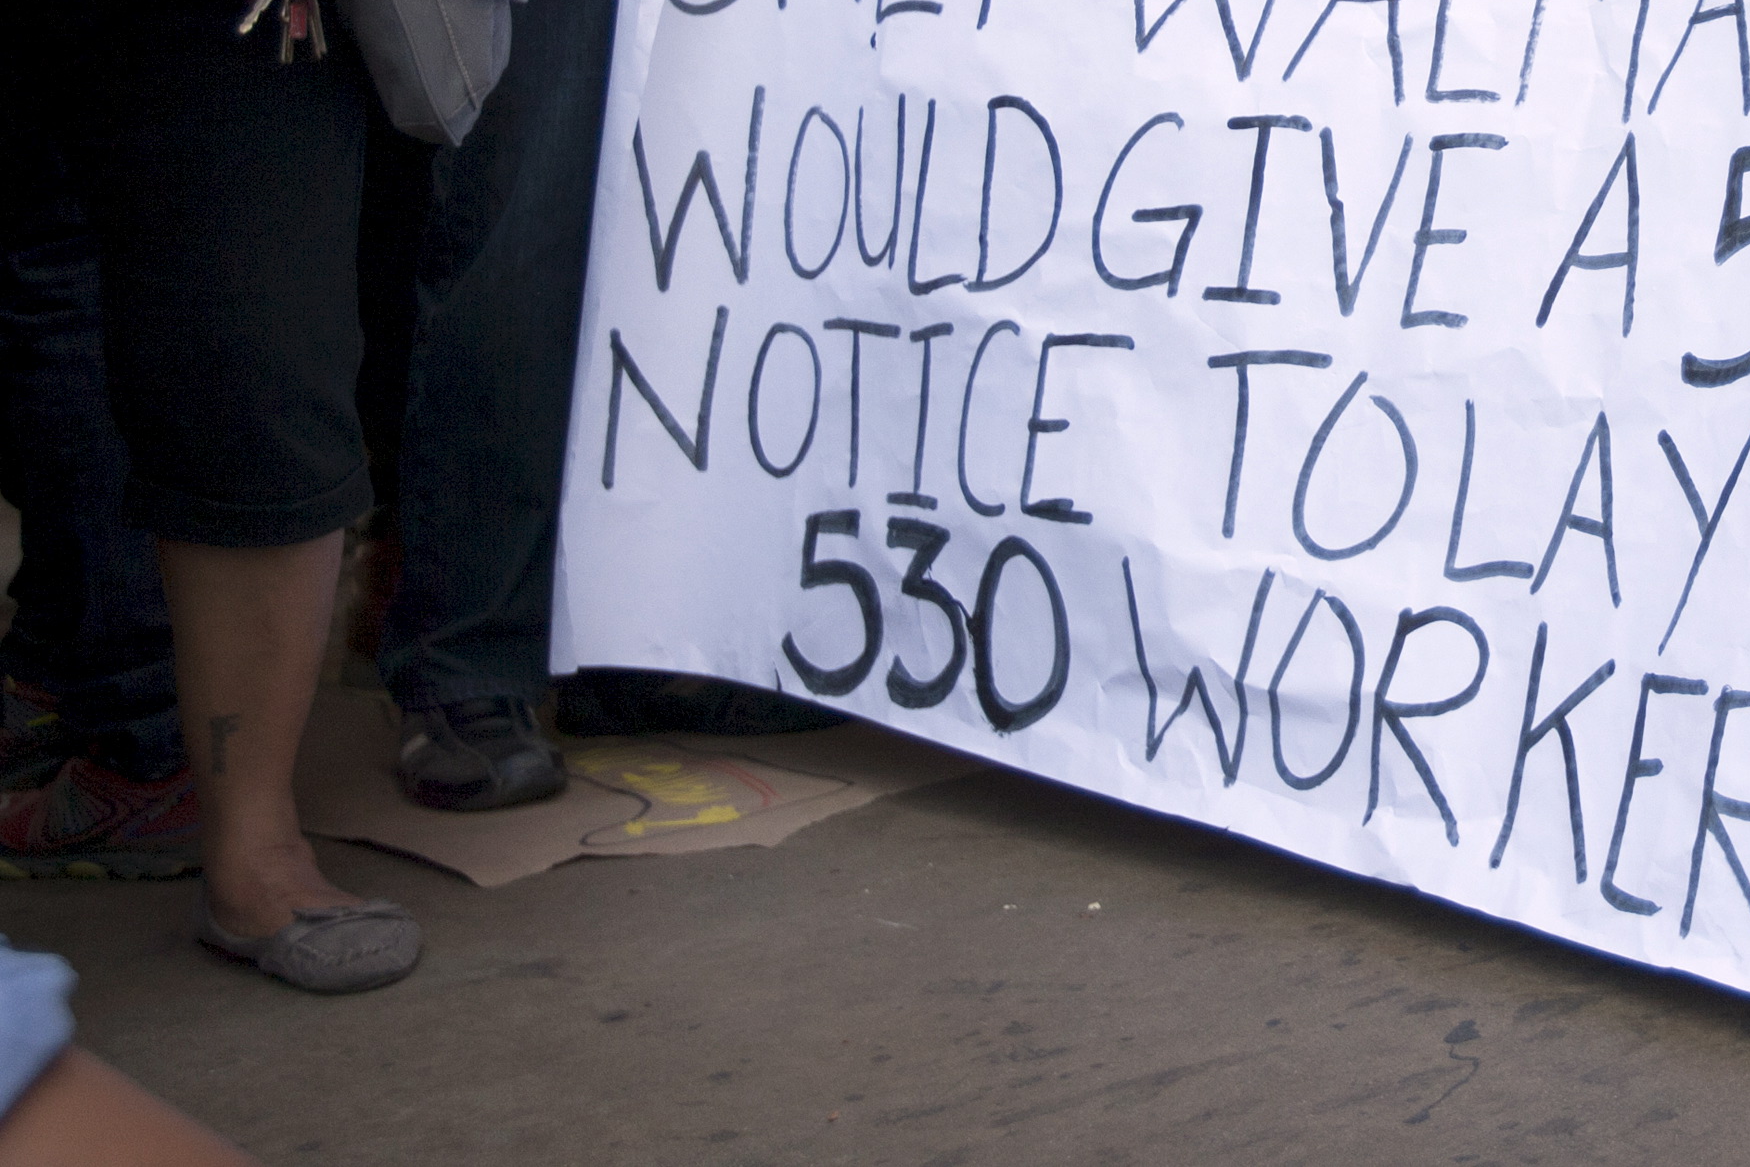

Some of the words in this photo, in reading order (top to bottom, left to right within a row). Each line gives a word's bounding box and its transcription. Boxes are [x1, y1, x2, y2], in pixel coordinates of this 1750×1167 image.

[633, 84, 1063, 295] WOULD
[1091, 111, 1510, 328] GIVE
[1535, 131, 1641, 338] A
[600, 304, 1136, 524] NOTICE
[781, 508, 1071, 736] 530
